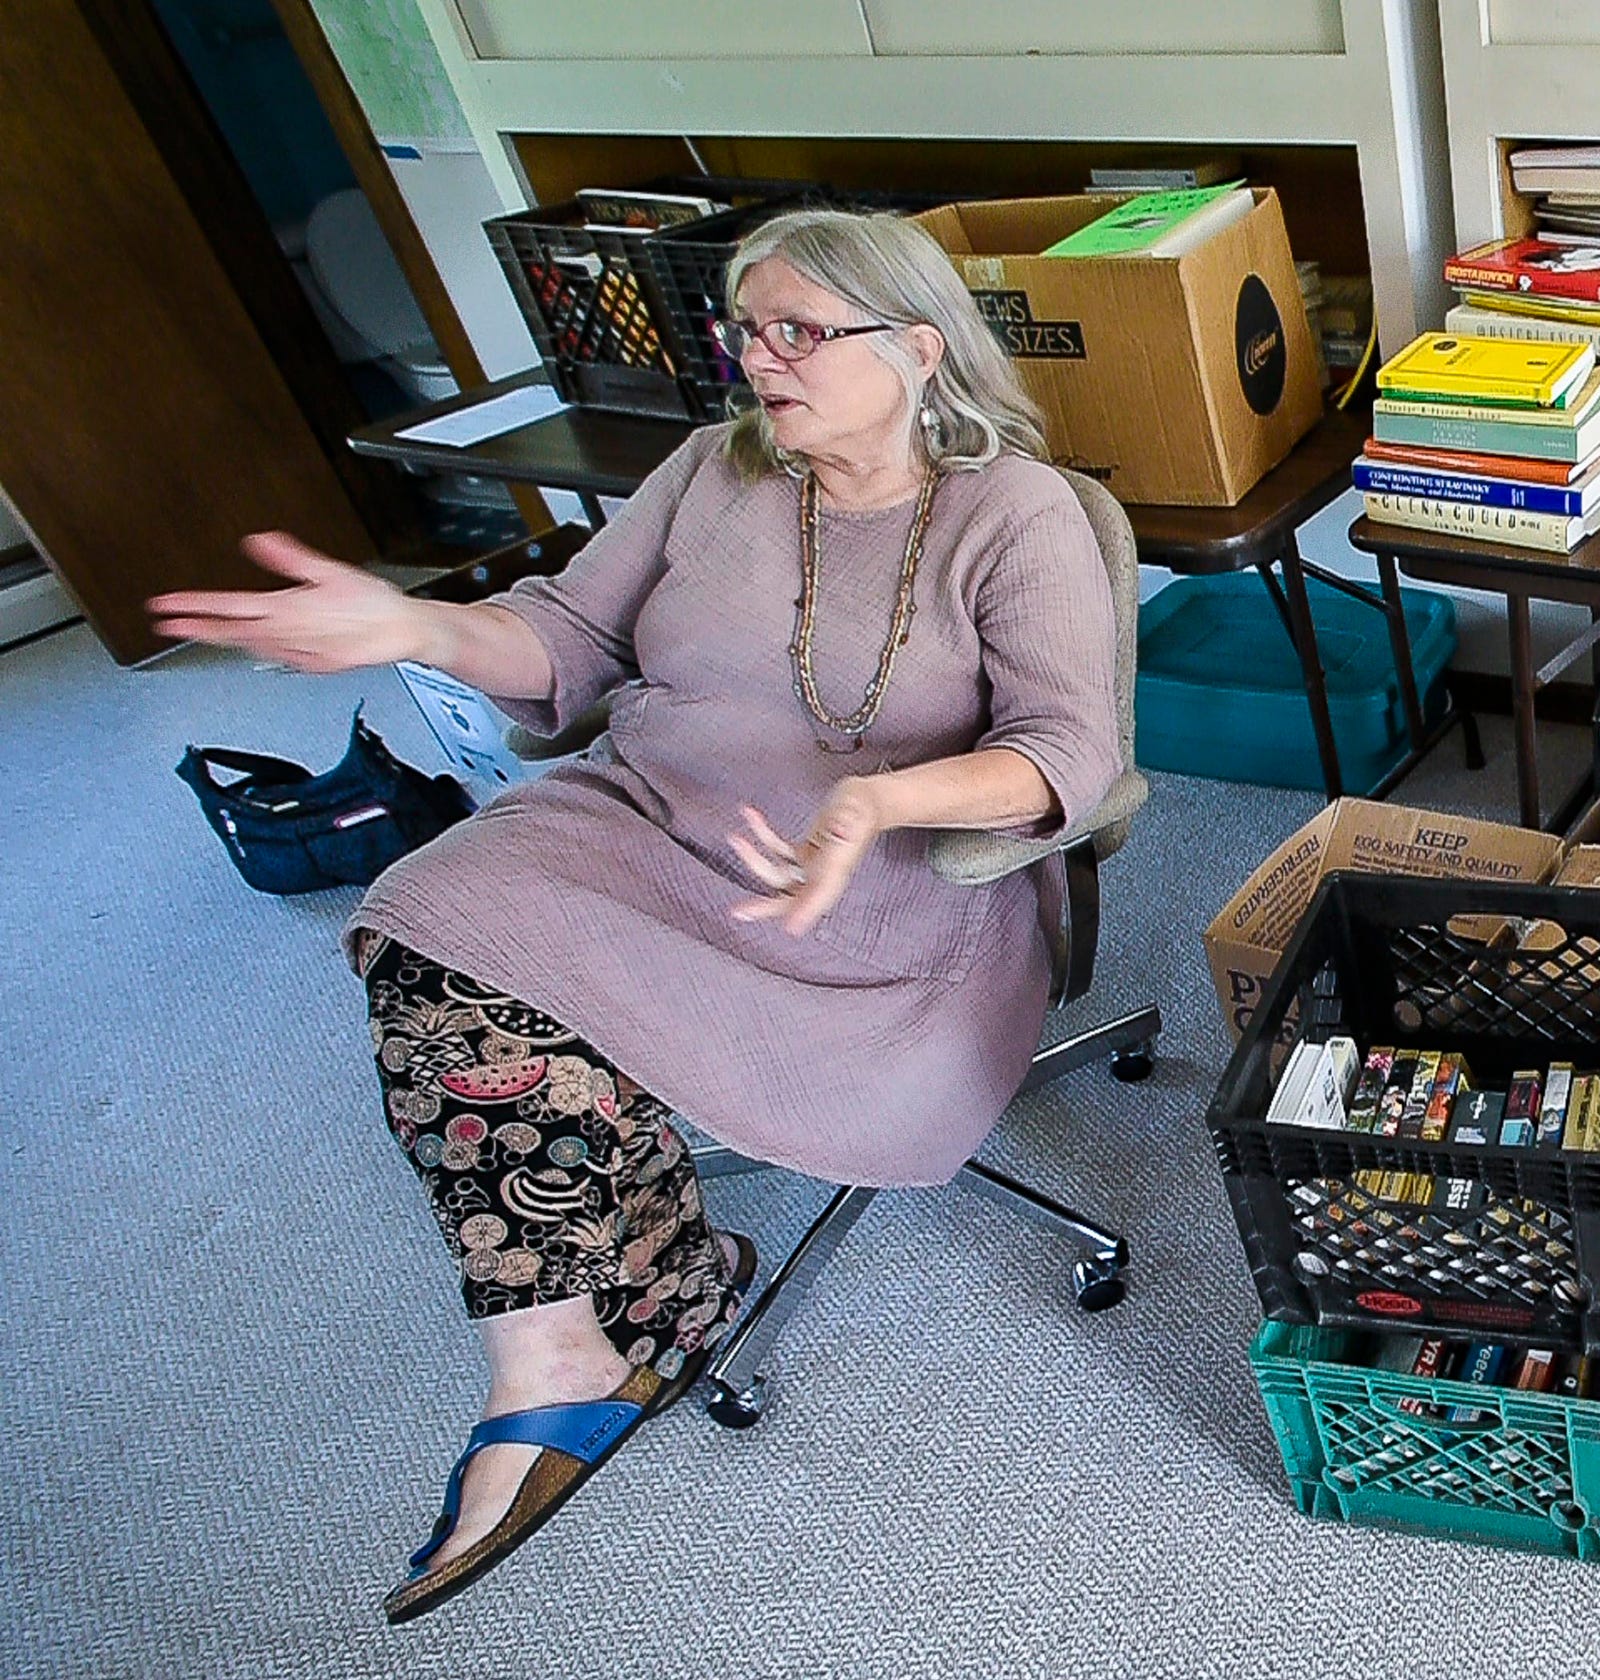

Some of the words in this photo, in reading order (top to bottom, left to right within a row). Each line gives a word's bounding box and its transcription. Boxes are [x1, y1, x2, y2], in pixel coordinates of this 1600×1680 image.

[1007, 326, 1081, 353] SIZES.
[1437, 478, 1491, 494] STRAVINSKY
[1453, 507, 1516, 529] GOULD
[1414, 828, 1469, 850] KEEP
[1353, 835, 1381, 854] EGG
[1384, 840, 1431, 862] SAFETY
[1433, 848, 1462, 866] AND
[1465, 855, 1523, 877] QUALITY
[1233, 834, 1321, 929] REFRIGERATED
